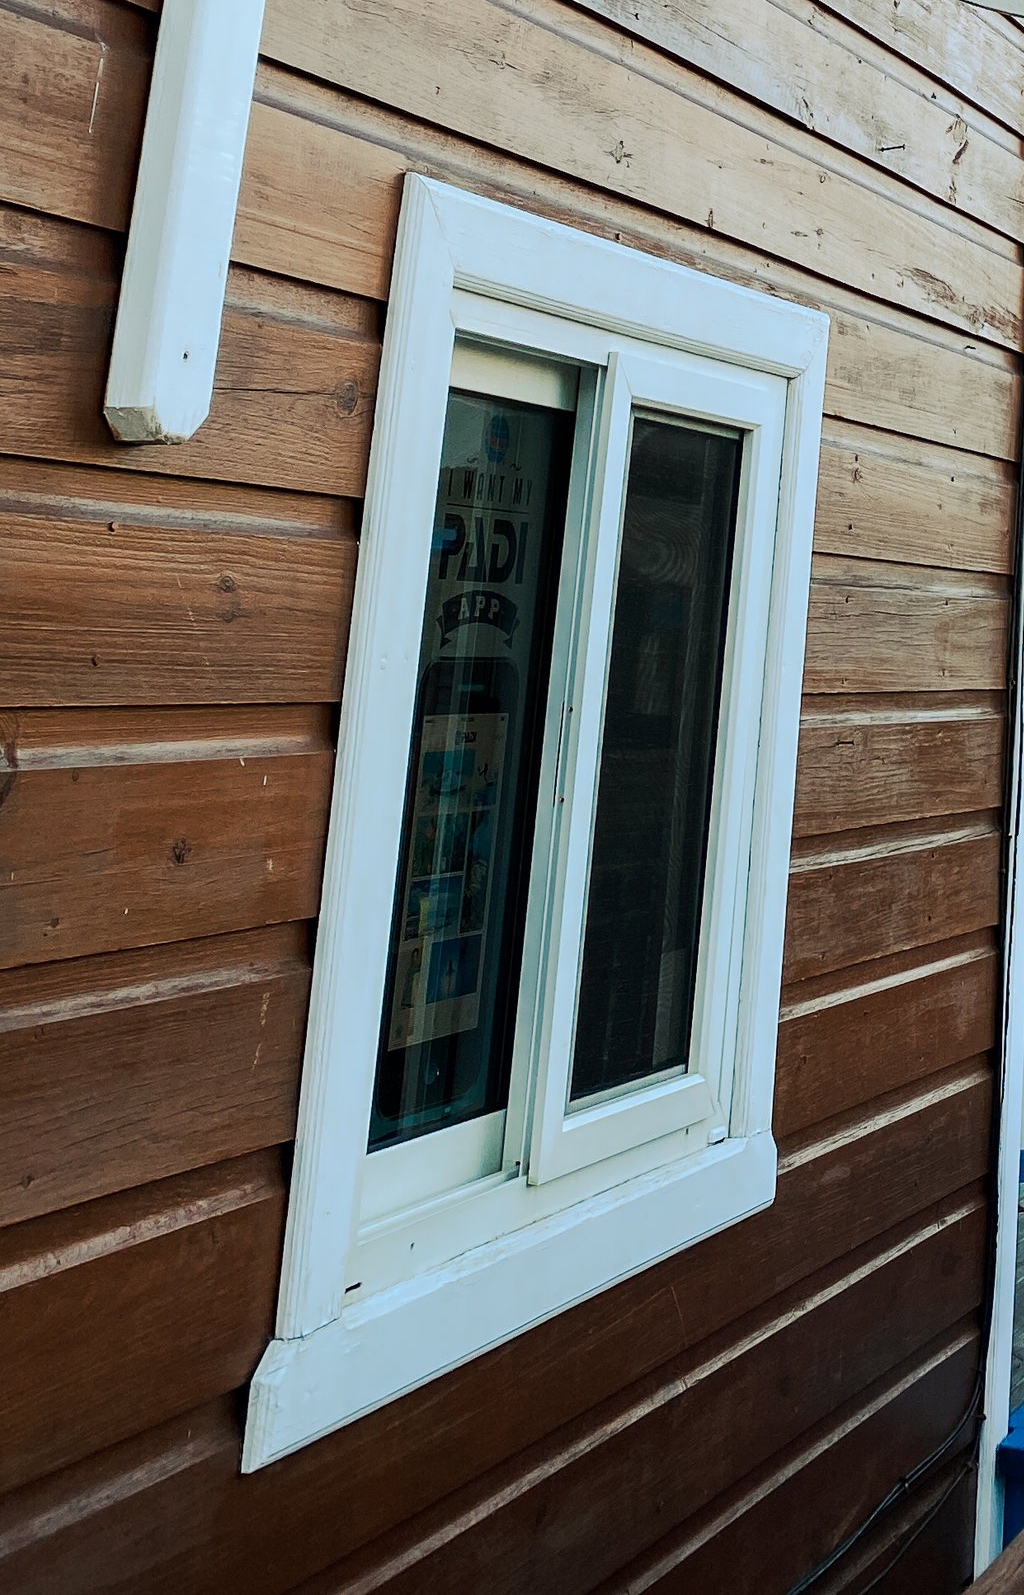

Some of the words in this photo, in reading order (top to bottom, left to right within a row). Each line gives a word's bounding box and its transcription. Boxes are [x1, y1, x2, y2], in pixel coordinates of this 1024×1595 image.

[448, 468, 454, 497] I
[463, 470, 506, 503] WANT
[513, 478, 533, 506] MY
[438, 513, 528, 585] PADI
[458, 596, 500, 620] APP
